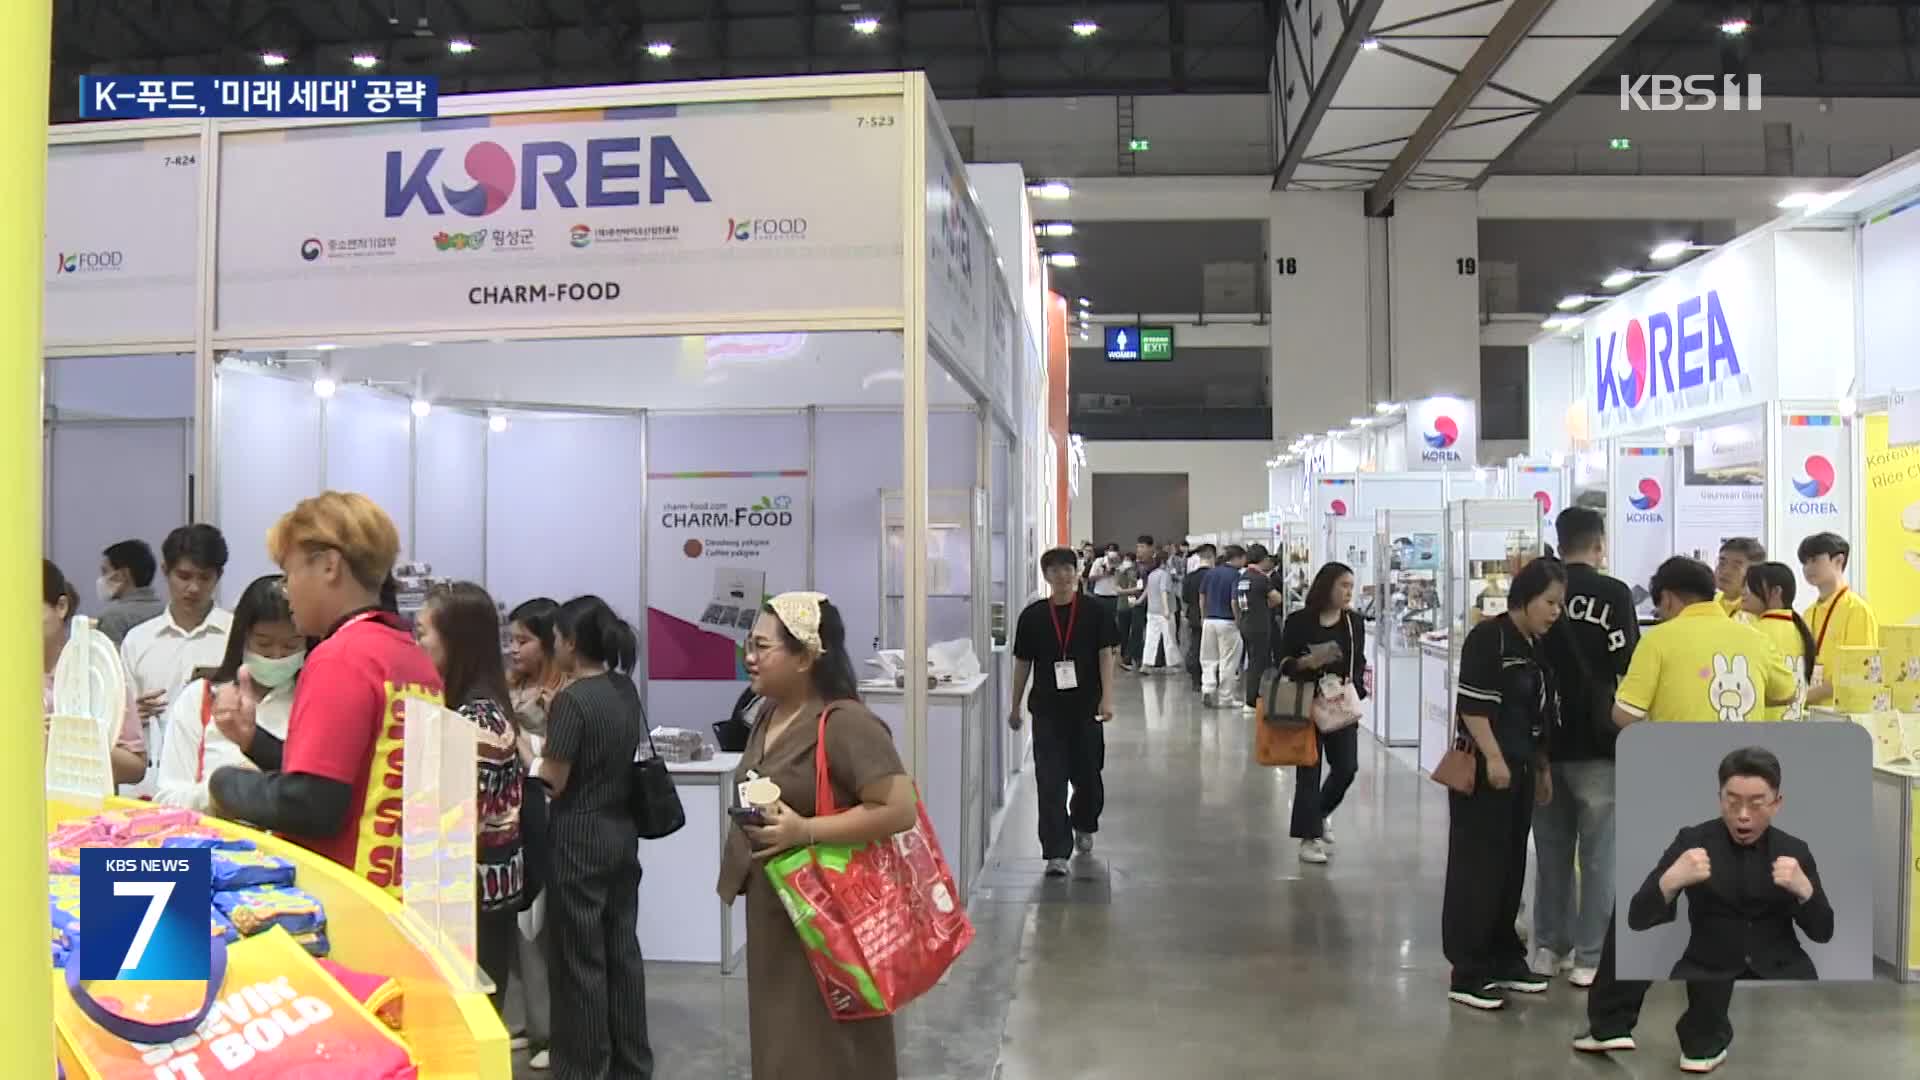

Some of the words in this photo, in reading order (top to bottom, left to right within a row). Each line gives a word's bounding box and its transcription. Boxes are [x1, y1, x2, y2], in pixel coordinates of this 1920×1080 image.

[385, 135, 712, 218] KOREA
[754, 218, 807, 235] FOOD
[79, 251, 122, 267] FOOD
[1276, 257, 1297, 275] 18
[1456, 257, 1476, 275] 19
[468, 282, 620, 304] CHARM-FOOD
[1108, 351, 1137, 360] WOMEN
[1143, 343, 1168, 352] EXIT
[1596, 290, 1741, 413] KOREA
[1422, 450, 1461, 461] KOREA
[1626, 512, 1663, 523] KOREA
[1790, 503, 1838, 515] KOREA
[209, 995, 334, 1071] BOLD
